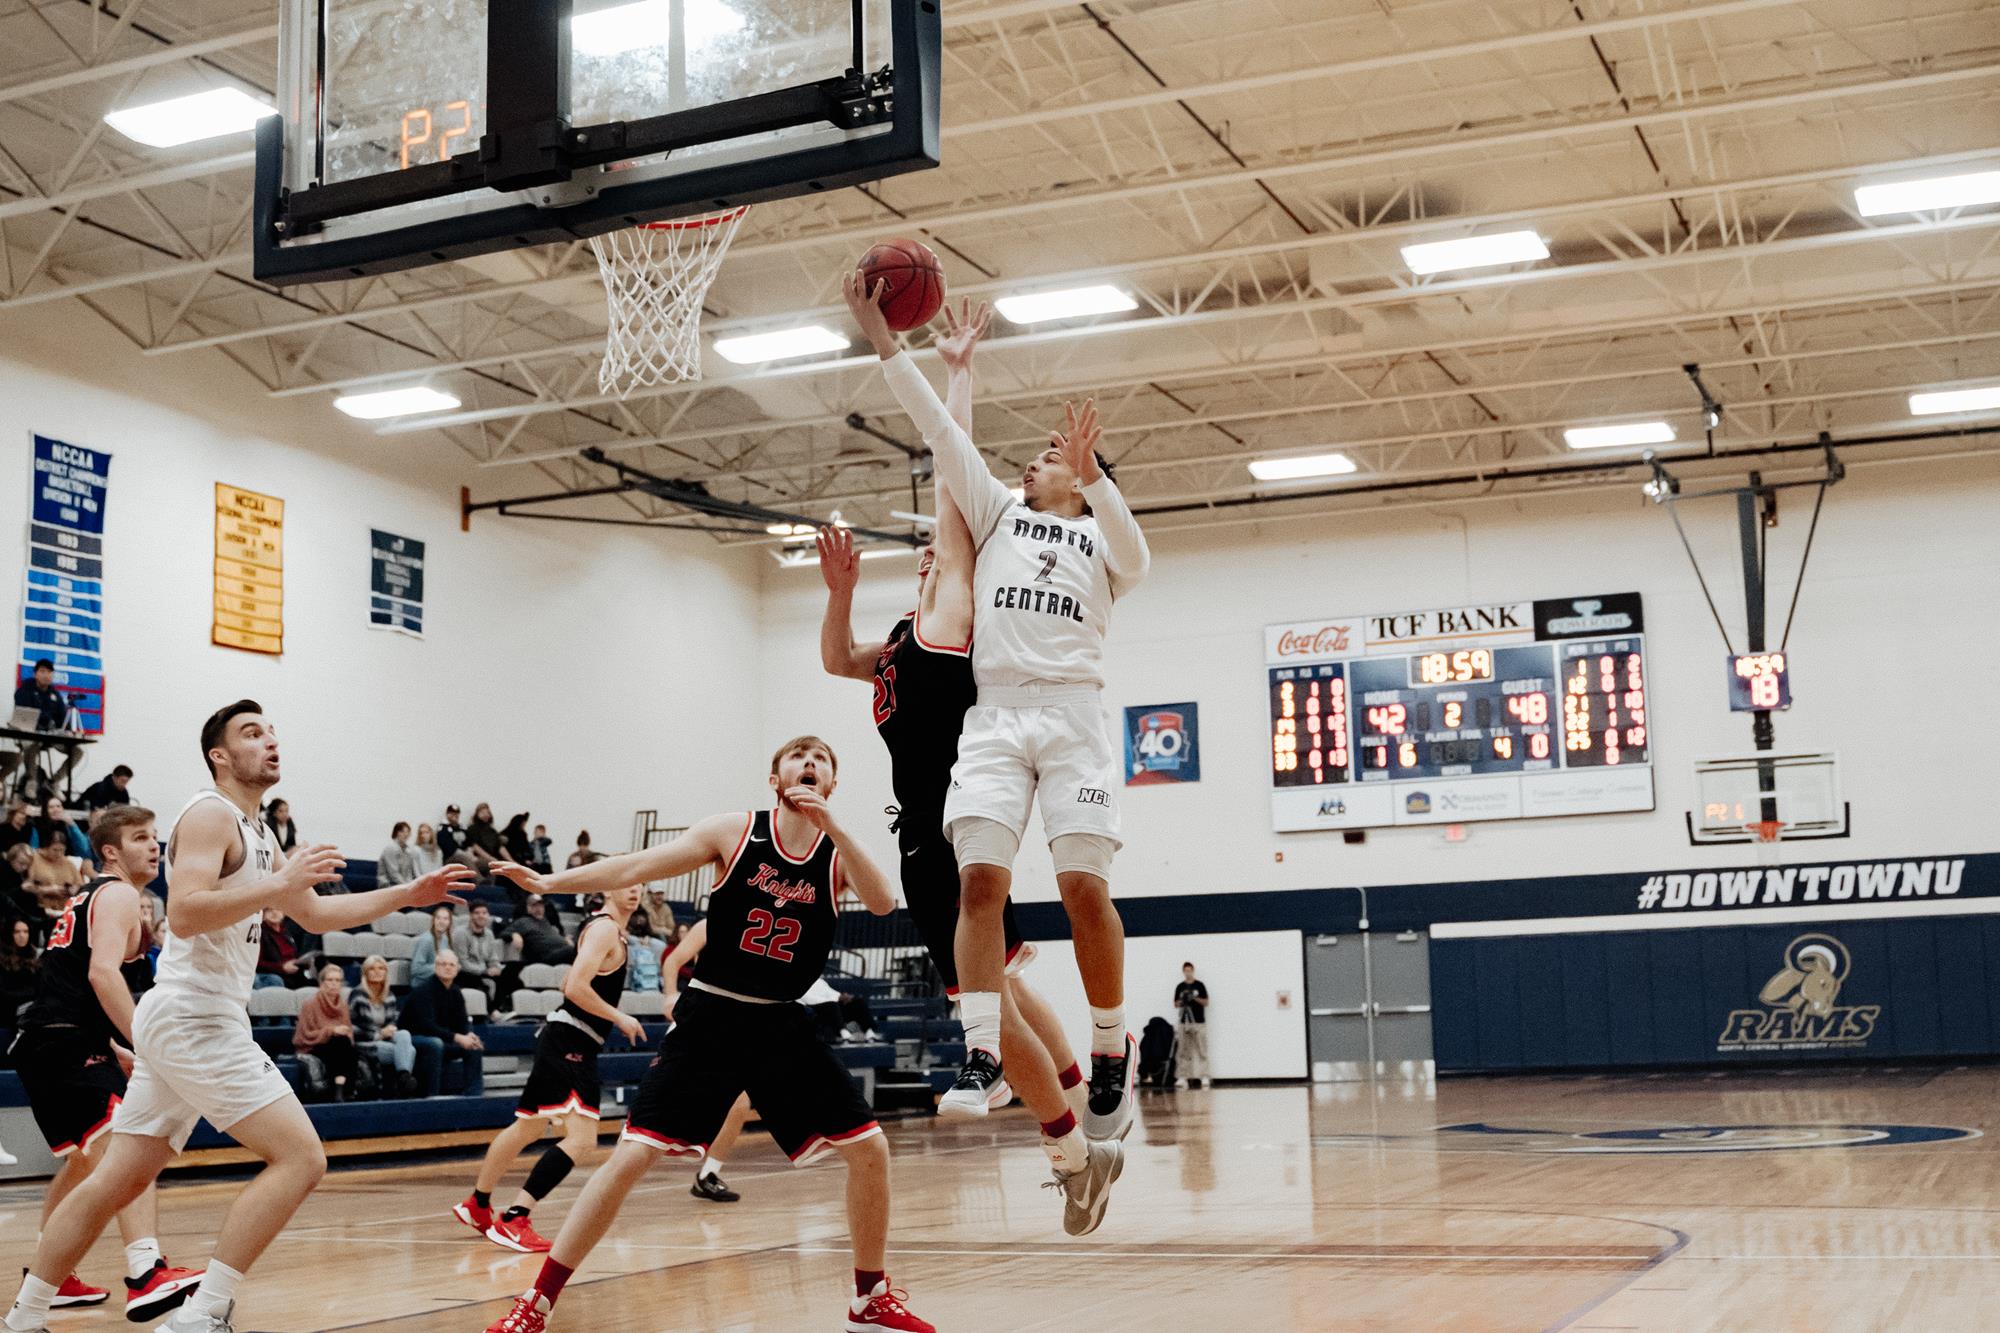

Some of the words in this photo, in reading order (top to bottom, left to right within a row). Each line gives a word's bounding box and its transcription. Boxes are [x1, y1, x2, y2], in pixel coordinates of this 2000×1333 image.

[51, 443, 94, 470] NCCAA
[1013, 518, 1093, 557] NORTH
[1034, 550, 1057, 584] 2
[994, 587, 1084, 622] CENTRAL
[1372, 614, 1426, 638] TCF
[1438, 605, 1520, 633] BANK
[873, 664, 896, 727] 21
[1565, 695, 1589, 713] 21
[1751, 674, 1779, 706] 18
[1368, 704, 1406, 734] 42
[1444, 702, 1462, 728] 2
[1508, 692, 1548, 724] 48
[1140, 729, 1182, 757] 40
[1376, 746, 1387, 767] 1
[1399, 742, 1417, 768] 6
[1493, 737, 1511, 759] 4
[1531, 733, 1549, 758] 0
[747, 863, 816, 908] Knights
[1637, 860, 1965, 909] #DOWNTOWNU
[739, 908, 802, 962] 22
[1718, 1005, 1881, 1044] RAMS
